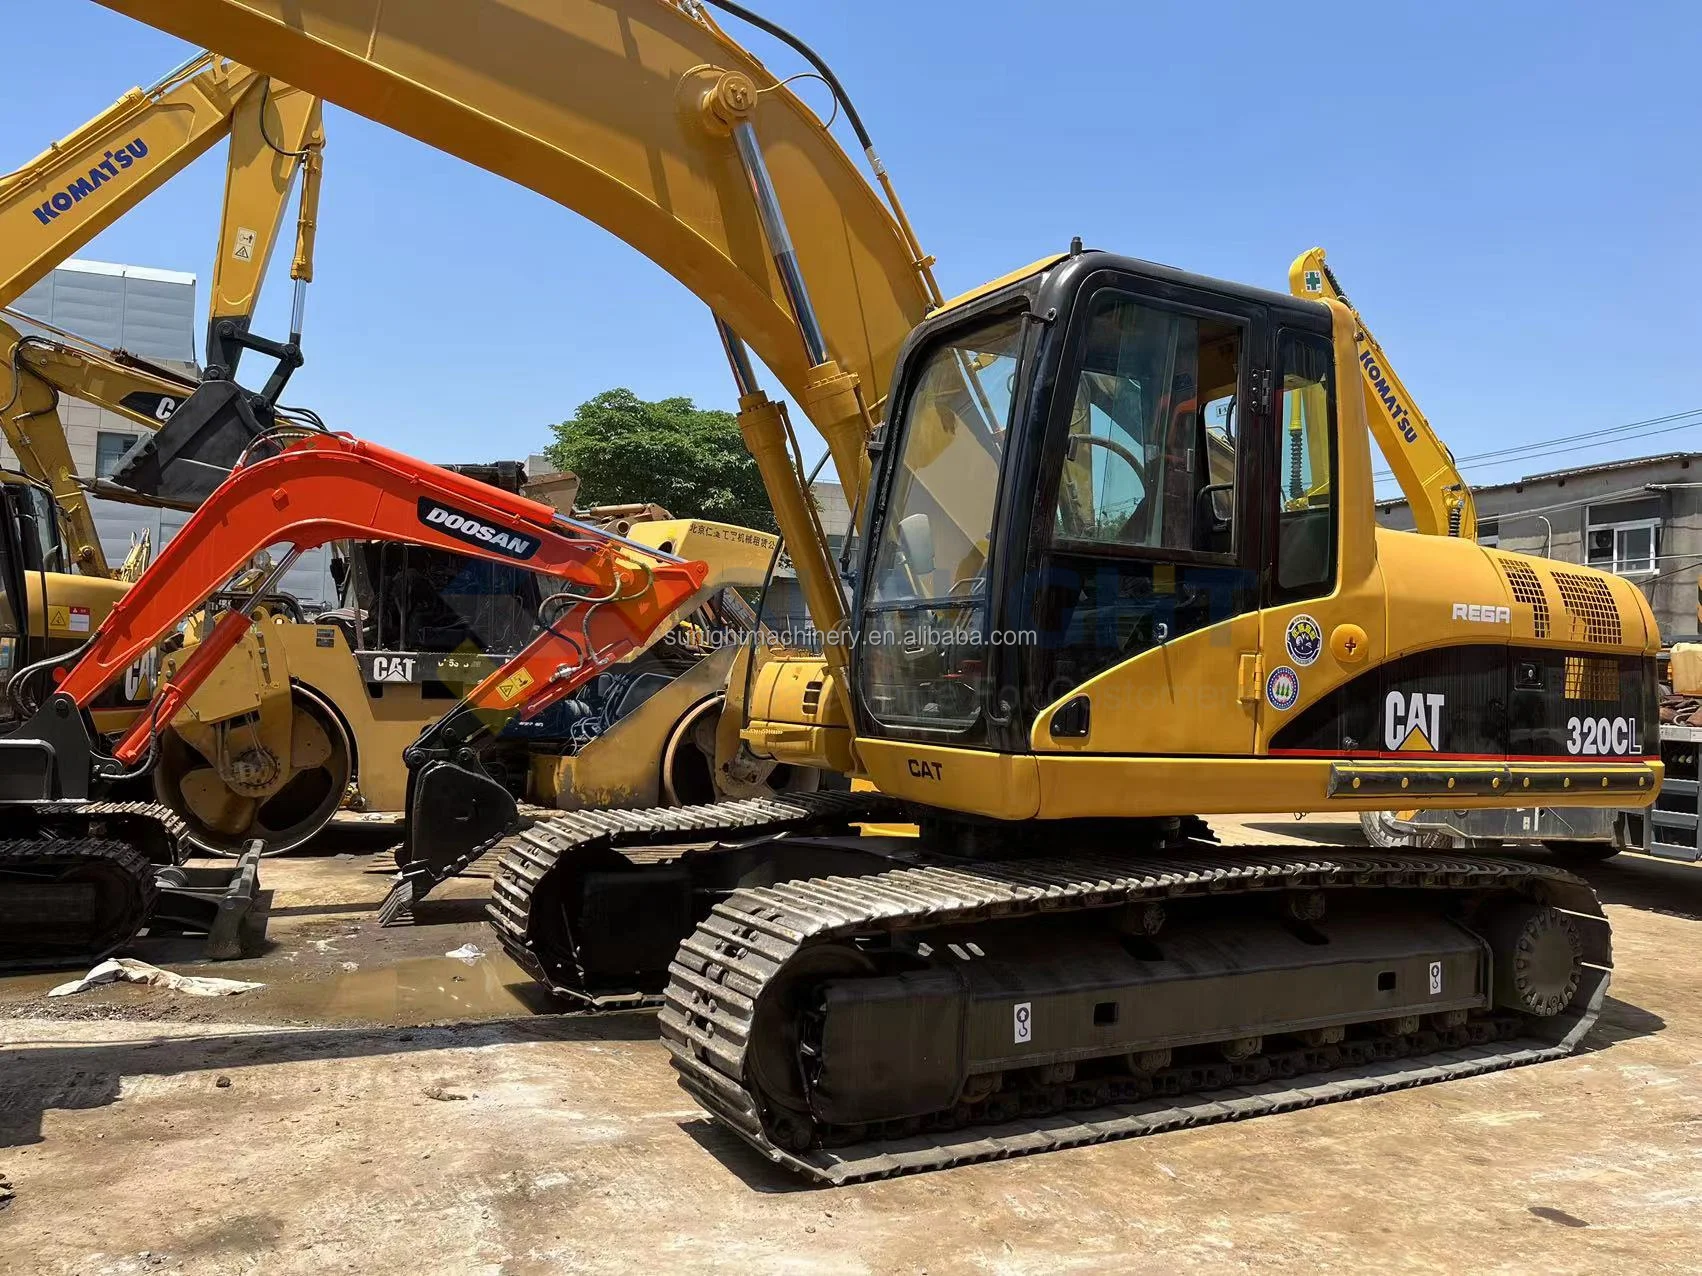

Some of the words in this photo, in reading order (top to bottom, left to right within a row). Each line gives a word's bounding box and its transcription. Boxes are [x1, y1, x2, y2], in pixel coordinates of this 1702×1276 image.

[32, 137, 149, 225] KOMATSU
[1359, 350, 1418, 443] KOMATSU
[425, 507, 530, 554] DOOSAN
[373, 656, 416, 682] CAT
[1385, 690, 1445, 752] CAT
[1566, 716, 1642, 755] 320CL
[907, 758, 943, 781] CAT
